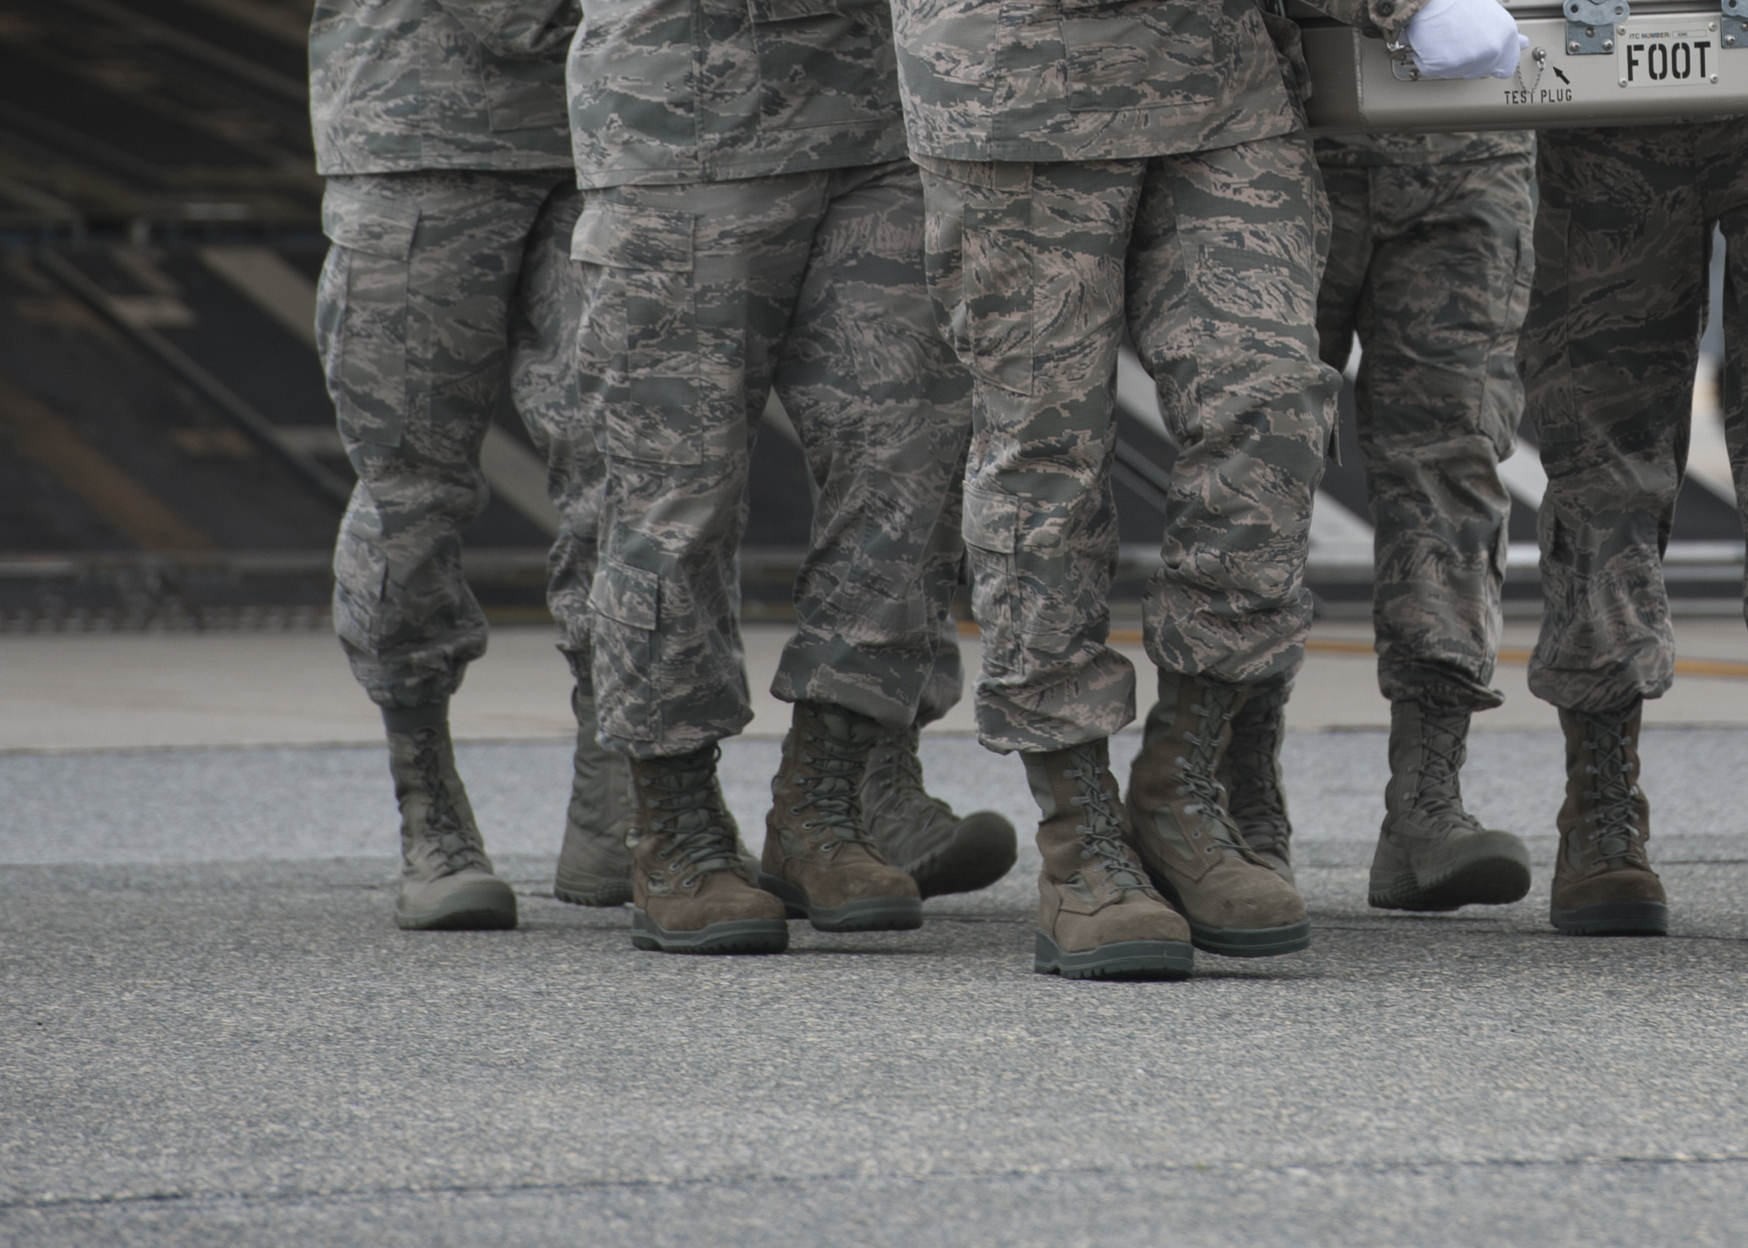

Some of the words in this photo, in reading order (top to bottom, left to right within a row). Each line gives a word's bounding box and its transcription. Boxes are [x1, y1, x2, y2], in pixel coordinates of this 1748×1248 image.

[1627, 41, 1711, 81] FOOT
[1504, 90, 1534, 105] TEST
[1541, 88, 1572, 103] PLUG
